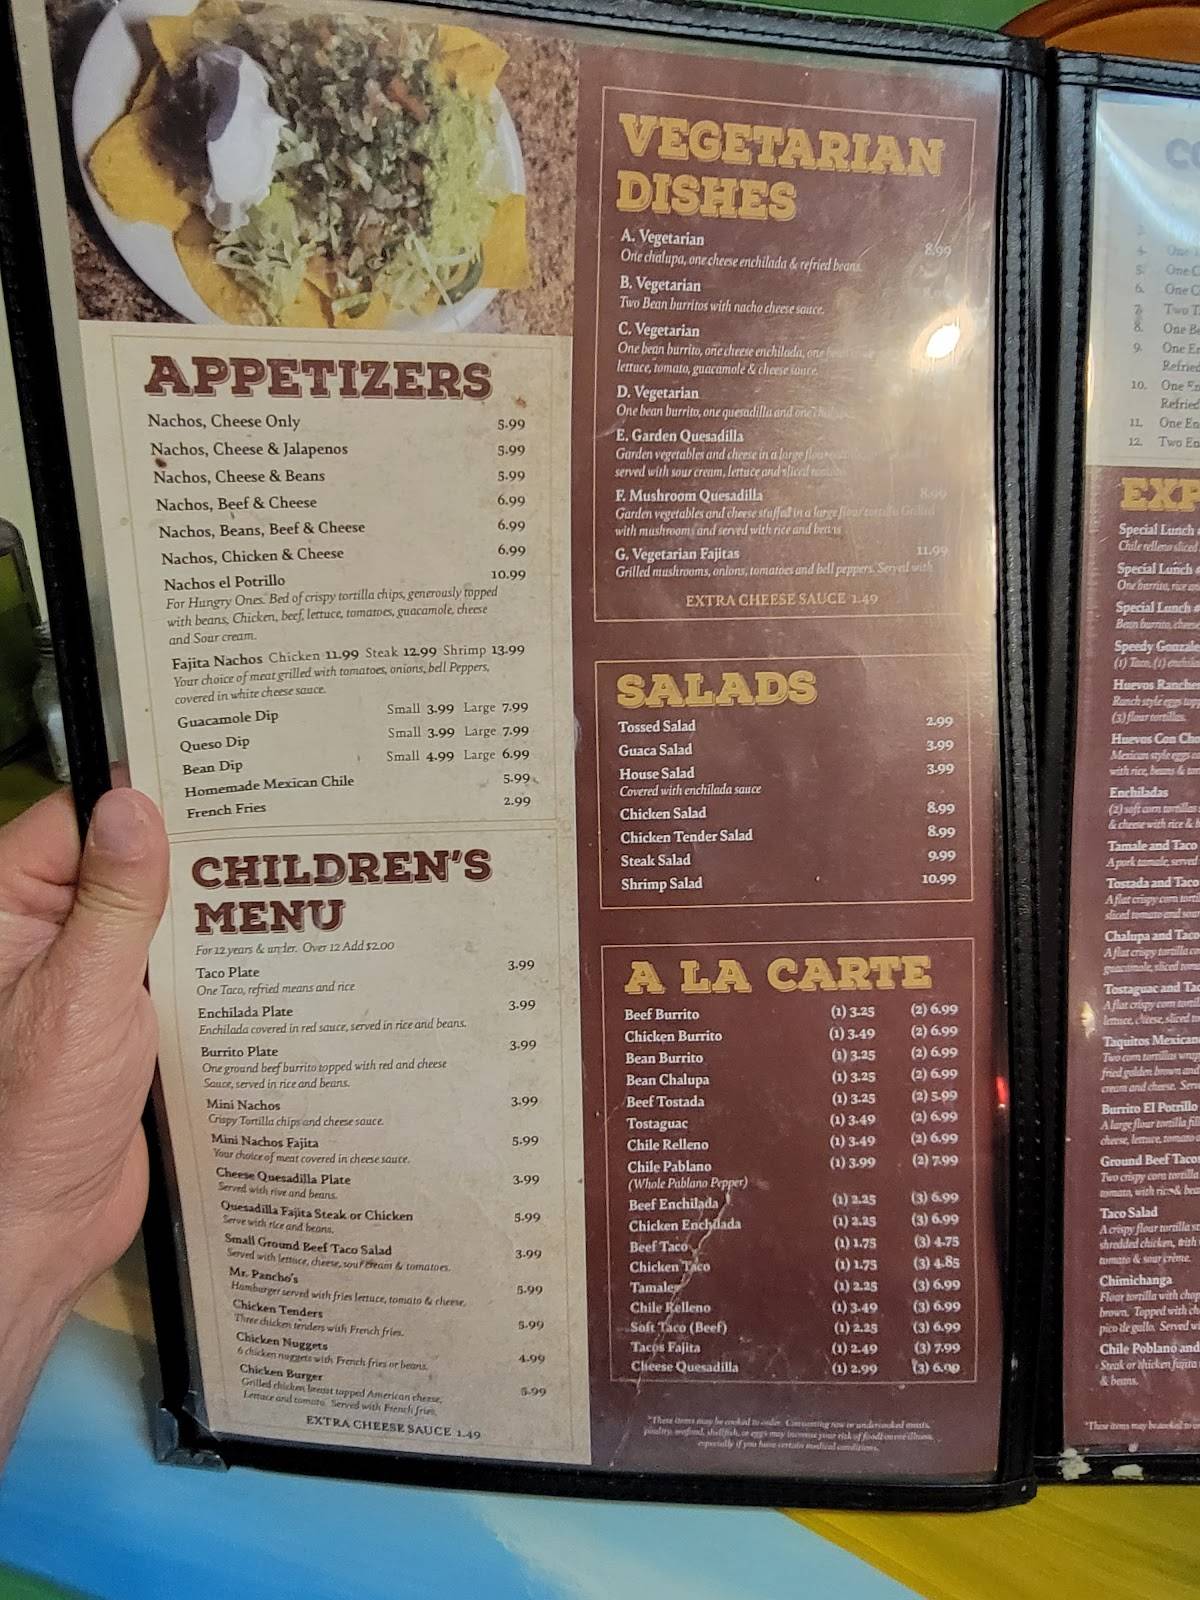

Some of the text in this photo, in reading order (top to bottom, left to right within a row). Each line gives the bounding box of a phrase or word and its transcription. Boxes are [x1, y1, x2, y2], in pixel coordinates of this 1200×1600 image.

[618, 113, 945, 177] VEGETARIAN
[616, 170, 798, 222] DISHES
[620, 228, 705, 248] A. Vegetarian
[619, 295, 825, 315] Two Bean burritos with nacho cheese sauce.
[144, 355, 494, 400] APPETIZERS
[147, 413, 301, 433] Nachos, Cheese Only
[497, 418, 526, 431] 5.99
[615, 428, 745, 445] E. Garden Quesadilla
[150, 441, 349, 459] Nachos, Cheese & Jalapenos
[497, 444, 526, 457] 5.99
[158, 520, 366, 539] Nachos, Beans, Beef & Cheese
[497, 518, 526, 533] 6.99
[1118, 522, 1195, 538] Special Lunch
[161, 547, 344, 566] Nachos, Chicken & Cheese
[497, 543, 526, 557] 6.99
[615, 547, 740, 564] G. Vegetarian Fajitas
[916, 545, 949, 557] 11.99
[164, 573, 286, 592] Nachos el Potrillo
[491, 569, 527, 581] 10.99
[685, 594, 736, 608] EXTRA
[738, 592, 796, 607] CHEESE
[798, 592, 846, 605] SAUCE
[167, 602, 488, 628] with beans, Chicken, beef, lettuce, tomatoes, guacamole, cheese
[171, 643, 525, 672] Fajita Nachos Chicken 11.99 Steak 12.99 Shrimp 13.99
[616, 671, 818, 709] SALADS
[387, 701, 529, 716] Small 3.99 Large 7.99
[177, 710, 279, 729] Guacamole Dip
[617, 719, 696, 733] Tossed Salad
[925, 716, 954, 728] 2.99
[184, 774, 355, 798] Homemade Mexican Chile
[503, 773, 531, 784] 5.99
[619, 782, 762, 797] Covered with enchilada sauce
[1109, 785, 1169, 799] Enchiladas
[503, 796, 532, 808] 2.99
[186, 802, 267, 819] French Fries
[620, 828, 754, 844] Chicken Tender Salad
[927, 824, 956, 839] 8.99
[1107, 839, 1199, 852] Tamale and Taco
[191, 849, 493, 890] CHILDREN'S
[621, 876, 703, 894] Shrimp Salad
[922, 873, 957, 885] 10.99
[195, 899, 346, 936] MENU
[195, 965, 260, 979] Taco Plate
[507, 959, 535, 971] 3.99
[624, 955, 933, 995] A LA CARTE
[196, 980, 356, 998] One Taco, refried means and rice
[197, 1005, 294, 1019] Enchilada Plate
[508, 999, 536, 1011] 3.99
[831, 1004, 875, 1020] (1) 3.25
[910, 1002, 959, 1017] (2) 6.99
[624, 1007, 700, 1021] Beef Burrito
[626, 1072, 710, 1089] Bean Chalupa
[206, 1098, 281, 1111] Mini Nachos
[511, 1095, 539, 1108] 3.99
[1101, 1099, 1199, 1115] Burrito El Potrillo
[625, 1117, 689, 1133] Tostaguac
[215, 1167, 352, 1186] Cheese Quesadilla Plate
[512, 1174, 540, 1185] 3.99
[627, 1175, 749, 1193] (Whole Pablano Pepper)
[1099, 1205, 1159, 1219] Taco Salad
[1099, 1273, 1173, 1289] Chimichanga
[235, 1331, 329, 1352] Chicken Nuggets
[518, 1354, 546, 1365] 4.99
[630, 1359, 739, 1375] Cheese Quesadilla
[306, 1415, 481, 1440] EXTRA CHEESE SAUCE 1.49
